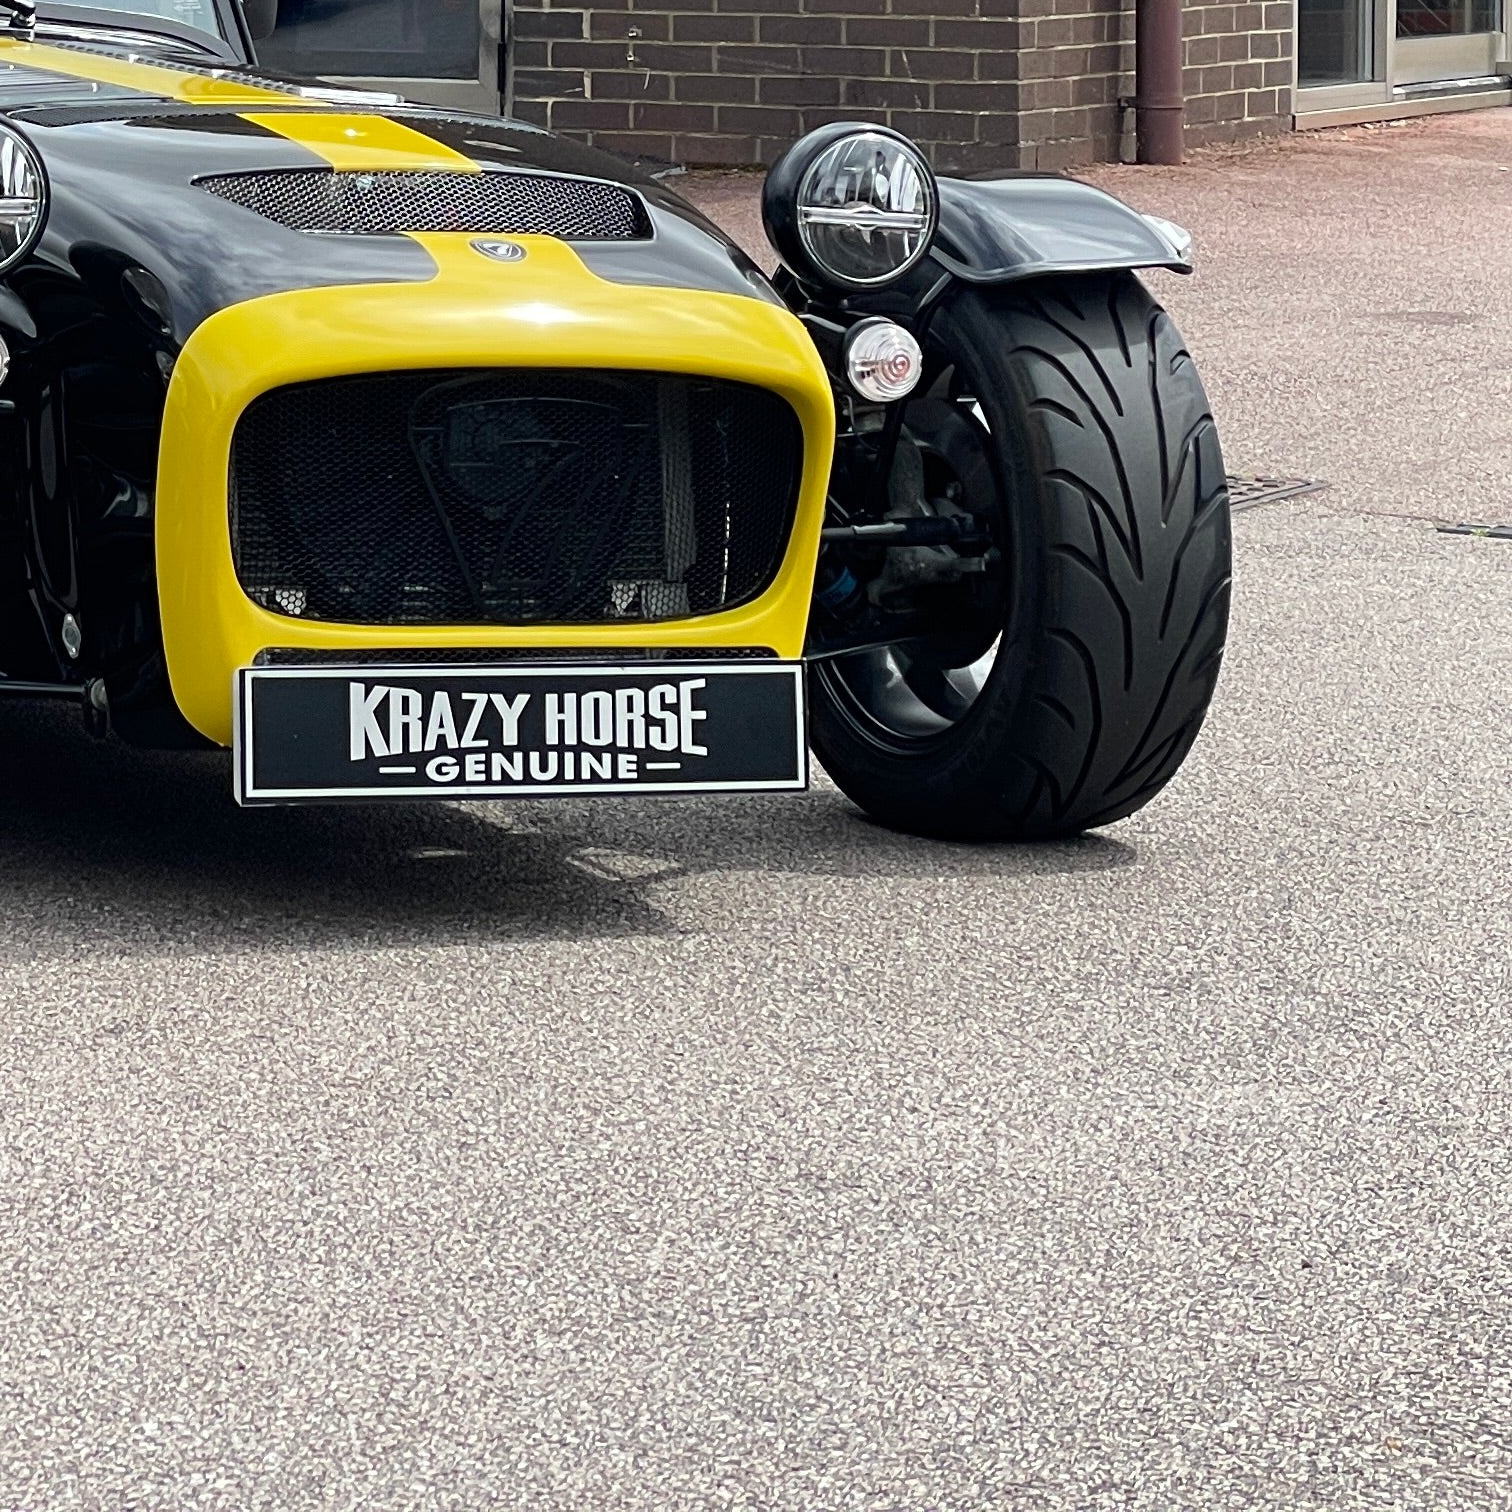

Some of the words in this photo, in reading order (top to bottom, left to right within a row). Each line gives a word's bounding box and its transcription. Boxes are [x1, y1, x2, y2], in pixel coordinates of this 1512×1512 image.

[348, 681, 532, 762] KRAZY
[545, 678, 708, 756] HORSE
[425, 751, 639, 783] GENUINE
